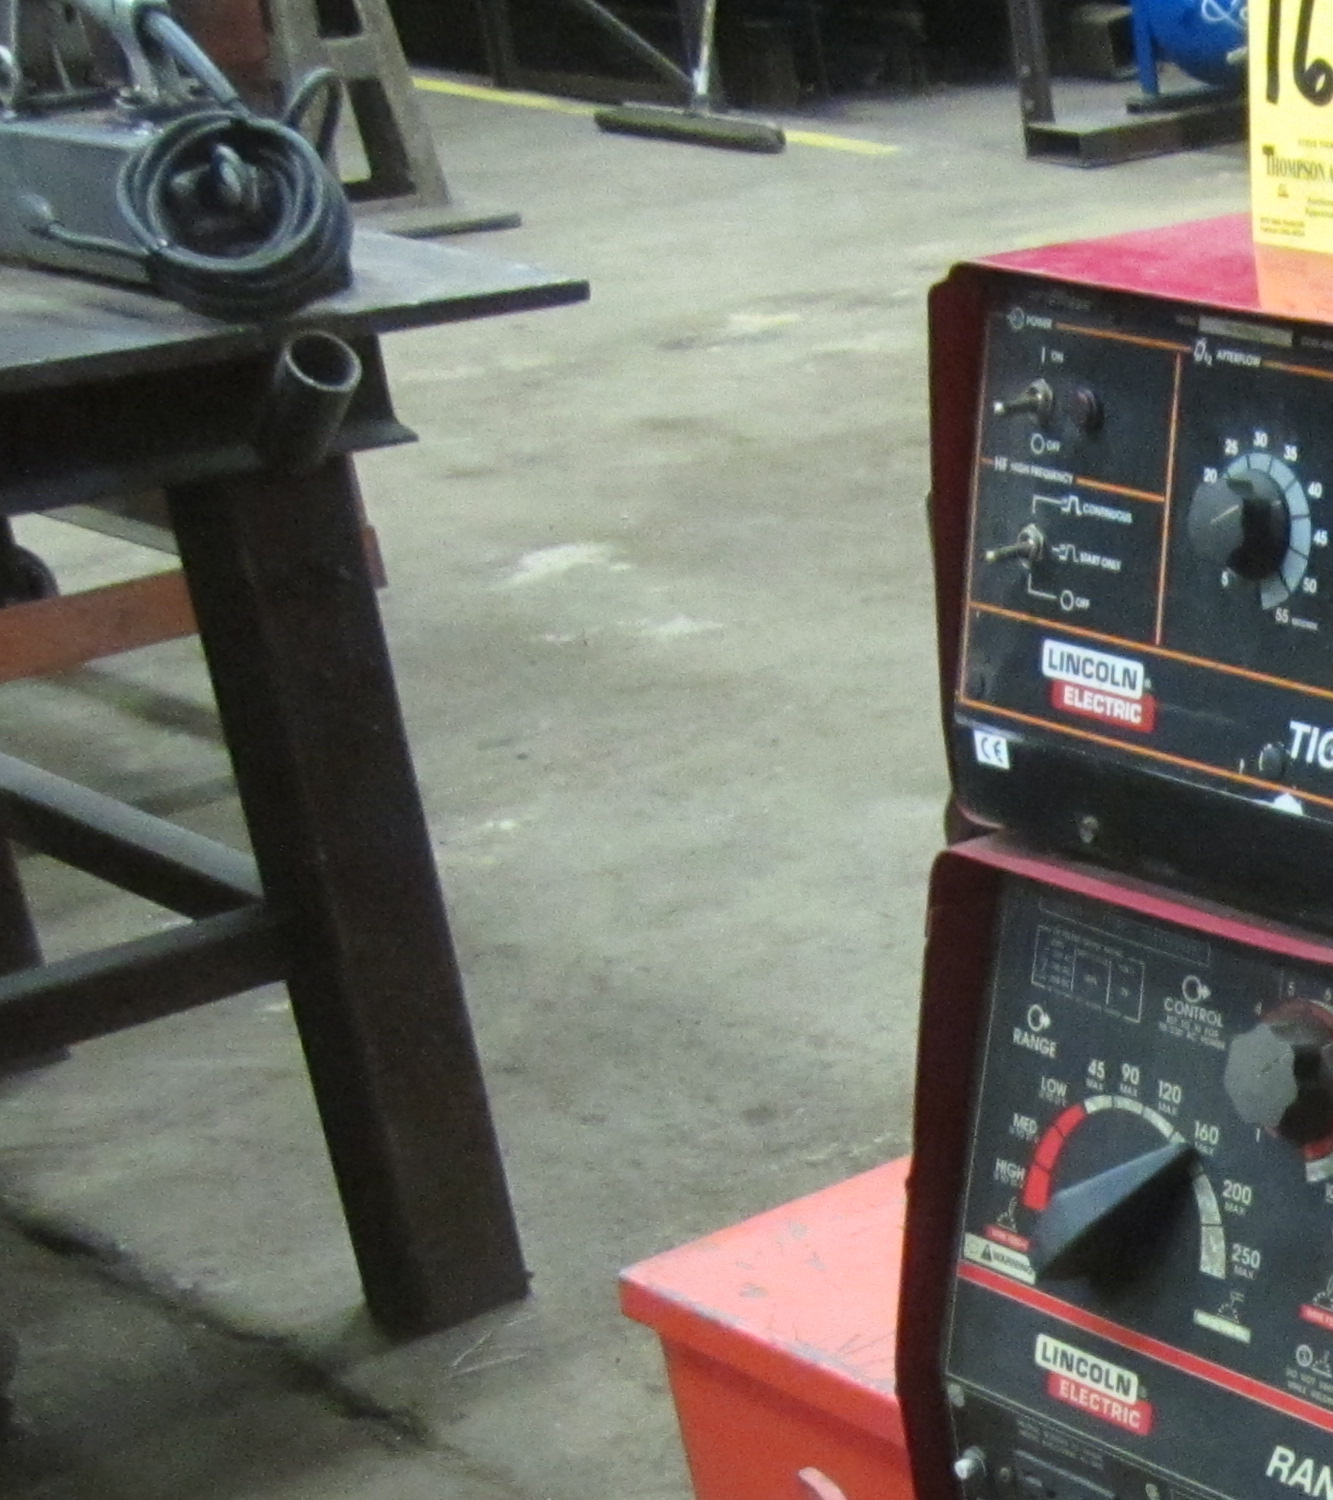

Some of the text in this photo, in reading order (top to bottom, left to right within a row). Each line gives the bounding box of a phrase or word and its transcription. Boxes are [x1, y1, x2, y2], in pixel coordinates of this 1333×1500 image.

[1266, 154, 1325, 181] THOMPSON
[1216, 350, 1262, 368] AFTERFLOW
[1224, 438, 1239, 455] 25
[1254, 431, 1269, 448] 30
[994, 455, 1008, 472] HF
[1284, 445, 1298, 462] 35
[1203, 467, 1217, 484] 20
[1307, 481, 1323, 499] 40
[1313, 529, 1329, 547] 45
[1221, 571, 1229, 587] 5
[1302, 577, 1318, 593] 50
[1275, 607, 1289, 623] 55
[1047, 648, 1139, 691] LINCOLN
[1063, 685, 1142, 724] ELECTRIC
[1163, 996, 1224, 1028] CONTROL
[1012, 1027, 1058, 1059] RANGE
[1087, 1058, 1105, 1081] 45
[1121, 1062, 1140, 1085] 90
[1041, 1075, 1067, 1098] LOW
[1119, 1083, 1139, 1098] MAX
[1158, 1080, 1182, 1104] 120
[1158, 1101, 1178, 1116] MAX
[1013, 1112, 1038, 1135] MED
[1194, 1120, 1219, 1144] 160
[995, 1157, 1026, 1181] HIGH
[1223, 1179, 1253, 1207] 200
[1224, 1203, 1247, 1217] MAX
[1231, 1243, 1261, 1269] 250
[1233, 1264, 1255, 1281] MAX
[1041, 1341, 1132, 1398] LINCOLN
[1059, 1380, 1142, 1429] ELECTRIC
